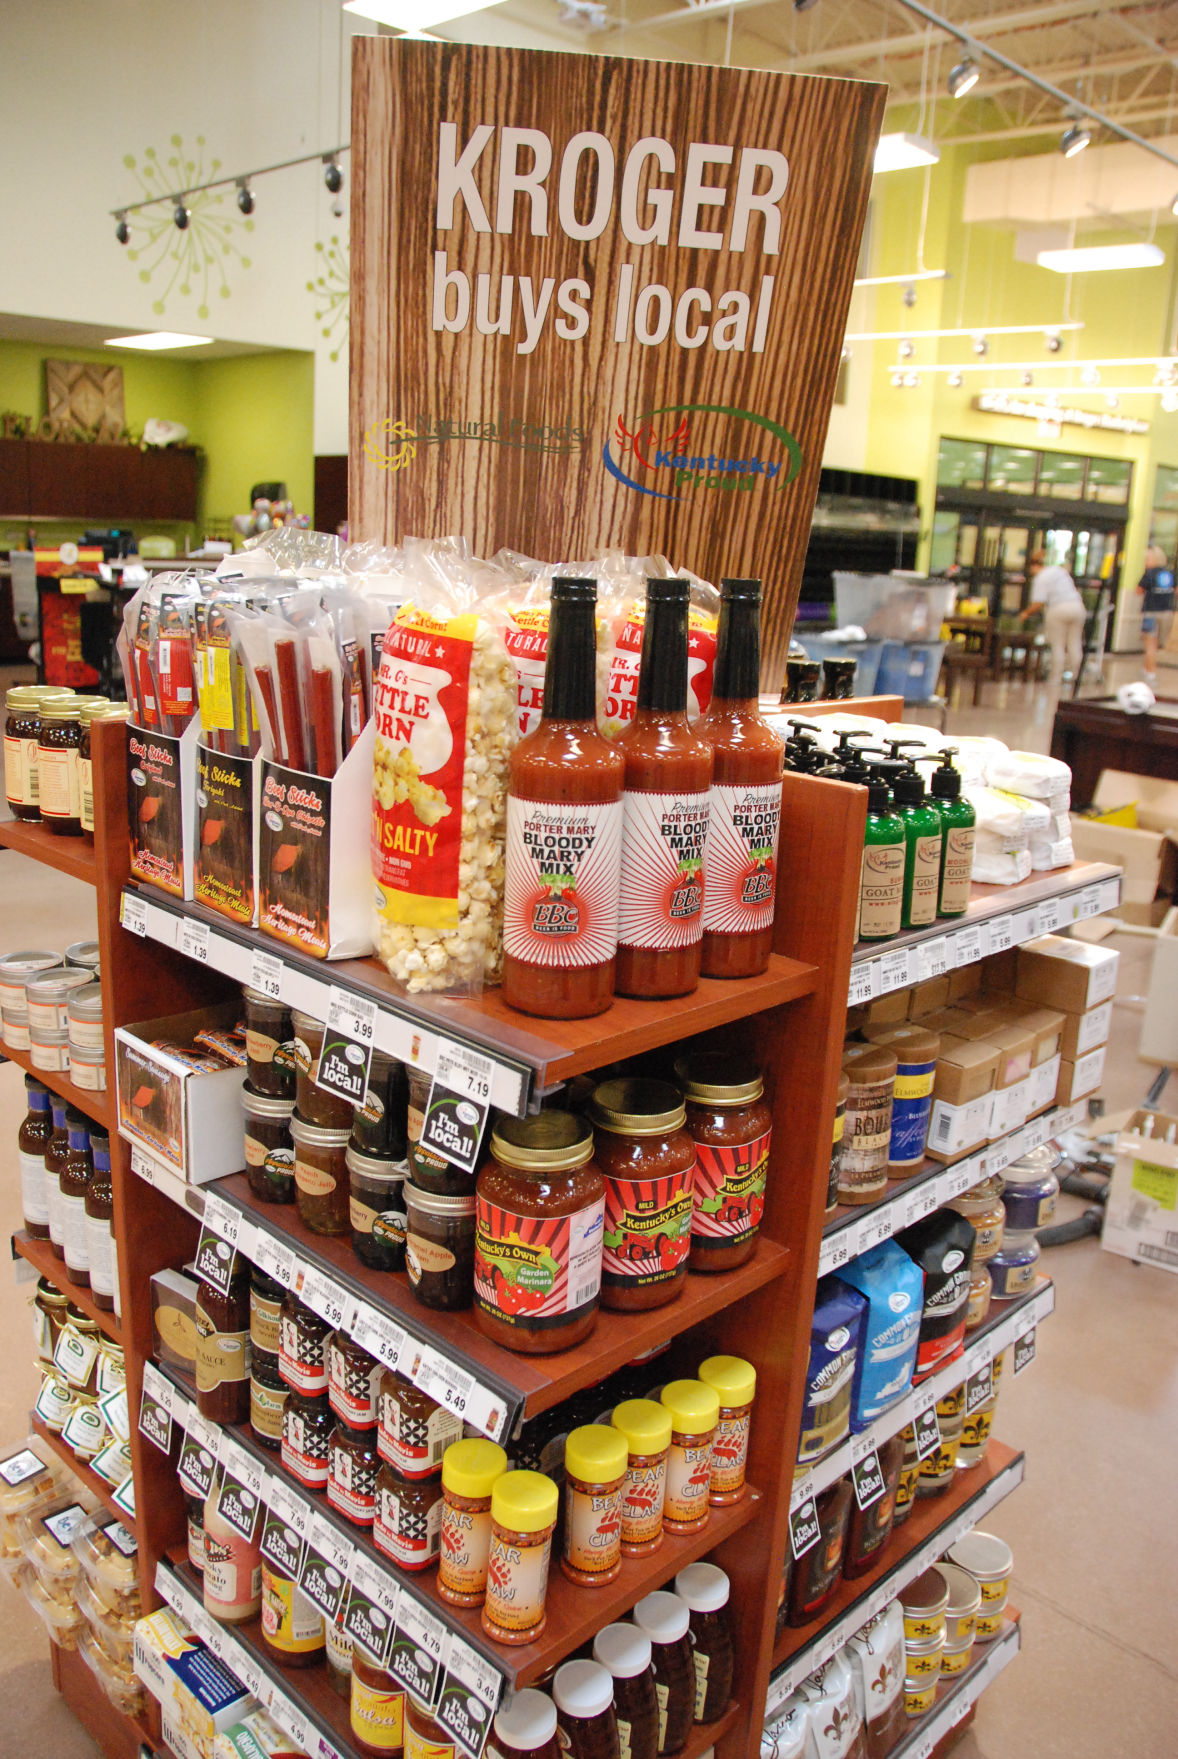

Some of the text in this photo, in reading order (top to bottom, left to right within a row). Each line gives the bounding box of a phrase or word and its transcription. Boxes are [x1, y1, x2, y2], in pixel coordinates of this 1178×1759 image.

[435, 121, 790, 255] KROGER
[432, 250, 775, 354] buys local
[416, 412, 584, 442] Natural Foods
[654, 449, 782, 479] Kentucky
[675, 469, 754, 492] Proud
[129, 737, 173, 766] Beef Sticks
[211, 765, 242, 788] Sticks
[264, 776, 322, 811] Beef Sticks
[531, 811, 590, 826] Premium
[662, 813, 698, 823] PORTER
[734, 804, 768, 813] PORTER
[524, 821, 597, 836] PORTER MARY
[741, 823, 777, 838] MARY
[384, 822, 438, 857] SALTY
[523, 832, 596, 849] BLOODY
[670, 833, 707, 849] MARY
[750, 836, 773, 849] MIX
[531, 847, 586, 863] MARY
[678, 847, 703, 860] MIX
[540, 861, 574, 875] MIX
[866, 888, 894, 897] GOAT
[534, 904, 579, 924] BBC
[133, 920, 146, 934] 1.39
[261, 914, 328, 949] Heritage Meats
[194, 946, 207, 959] 1.39
[265, 979, 280, 995] 1.39
[354, 1020, 373, 1039] 3.99
[330, 1055, 349, 1075] I'm
[322, 1063, 362, 1095] local!
[467, 1076, 489, 1097] 7.19
[437, 1112, 459, 1136] I'm
[429, 1120, 473, 1158] local!
[426, 1157, 448, 1169] PROUD
[726, 1167, 762, 1192] Kentucky's
[638, 1202, 654, 1210] MILD
[626, 1208, 675, 1230] Kentucky's
[223, 1222, 237, 1240] 6.19
[384, 1231, 405, 1243] PROUD
[205, 1248, 220, 1268] I'm
[513, 1246, 537, 1262] Own
[199, 1254, 228, 1285] local!
[275, 1264, 290, 1283] 5.99
[520, 1268, 549, 1277] Garden
[517, 1276, 552, 1285] Marinara
[927, 1277, 956, 1307] COMMON
[324, 1303, 341, 1323] 5.99
[872, 1318, 906, 1347] COMMON
[380, 1343, 398, 1364] 5.99
[811, 1358, 843, 1391] COMMON
[445, 1389, 465, 1412] 5.49
[143, 1414, 167, 1445] local!
[147, 1411, 159, 1428] I'm
[183, 1456, 210, 1490] local!
[188, 1453, 202, 1472] I'm
[682, 1479, 711, 1498] CLA
[228, 1494, 243, 1514] I'm
[591, 1491, 622, 1512] BEA
[222, 1498, 251, 1532] local!
[291, 1511, 305, 1531] 7.99
[272, 1530, 287, 1551] I'm
[589, 1529, 620, 1547] CLA
[795, 1521, 817, 1548] local!
[266, 1534, 297, 1571] local!
[333, 1551, 349, 1570] 7.99
[311, 1568, 327, 1590] I'm
[304, 1572, 336, 1612] local!
[377, 1588, 394, 1610] 7.99
[356, 1609, 372, 1633] I'm
[350, 1613, 382, 1654] local!
[422, 1632, 440, 1653] 4.79
[401, 1650, 418, 1676] I'm
[394, 1655, 429, 1698] local!
[476, 1677, 495, 1702] 3.49
[451, 1697, 469, 1725] I'm
[443, 1703, 480, 1750] local!
